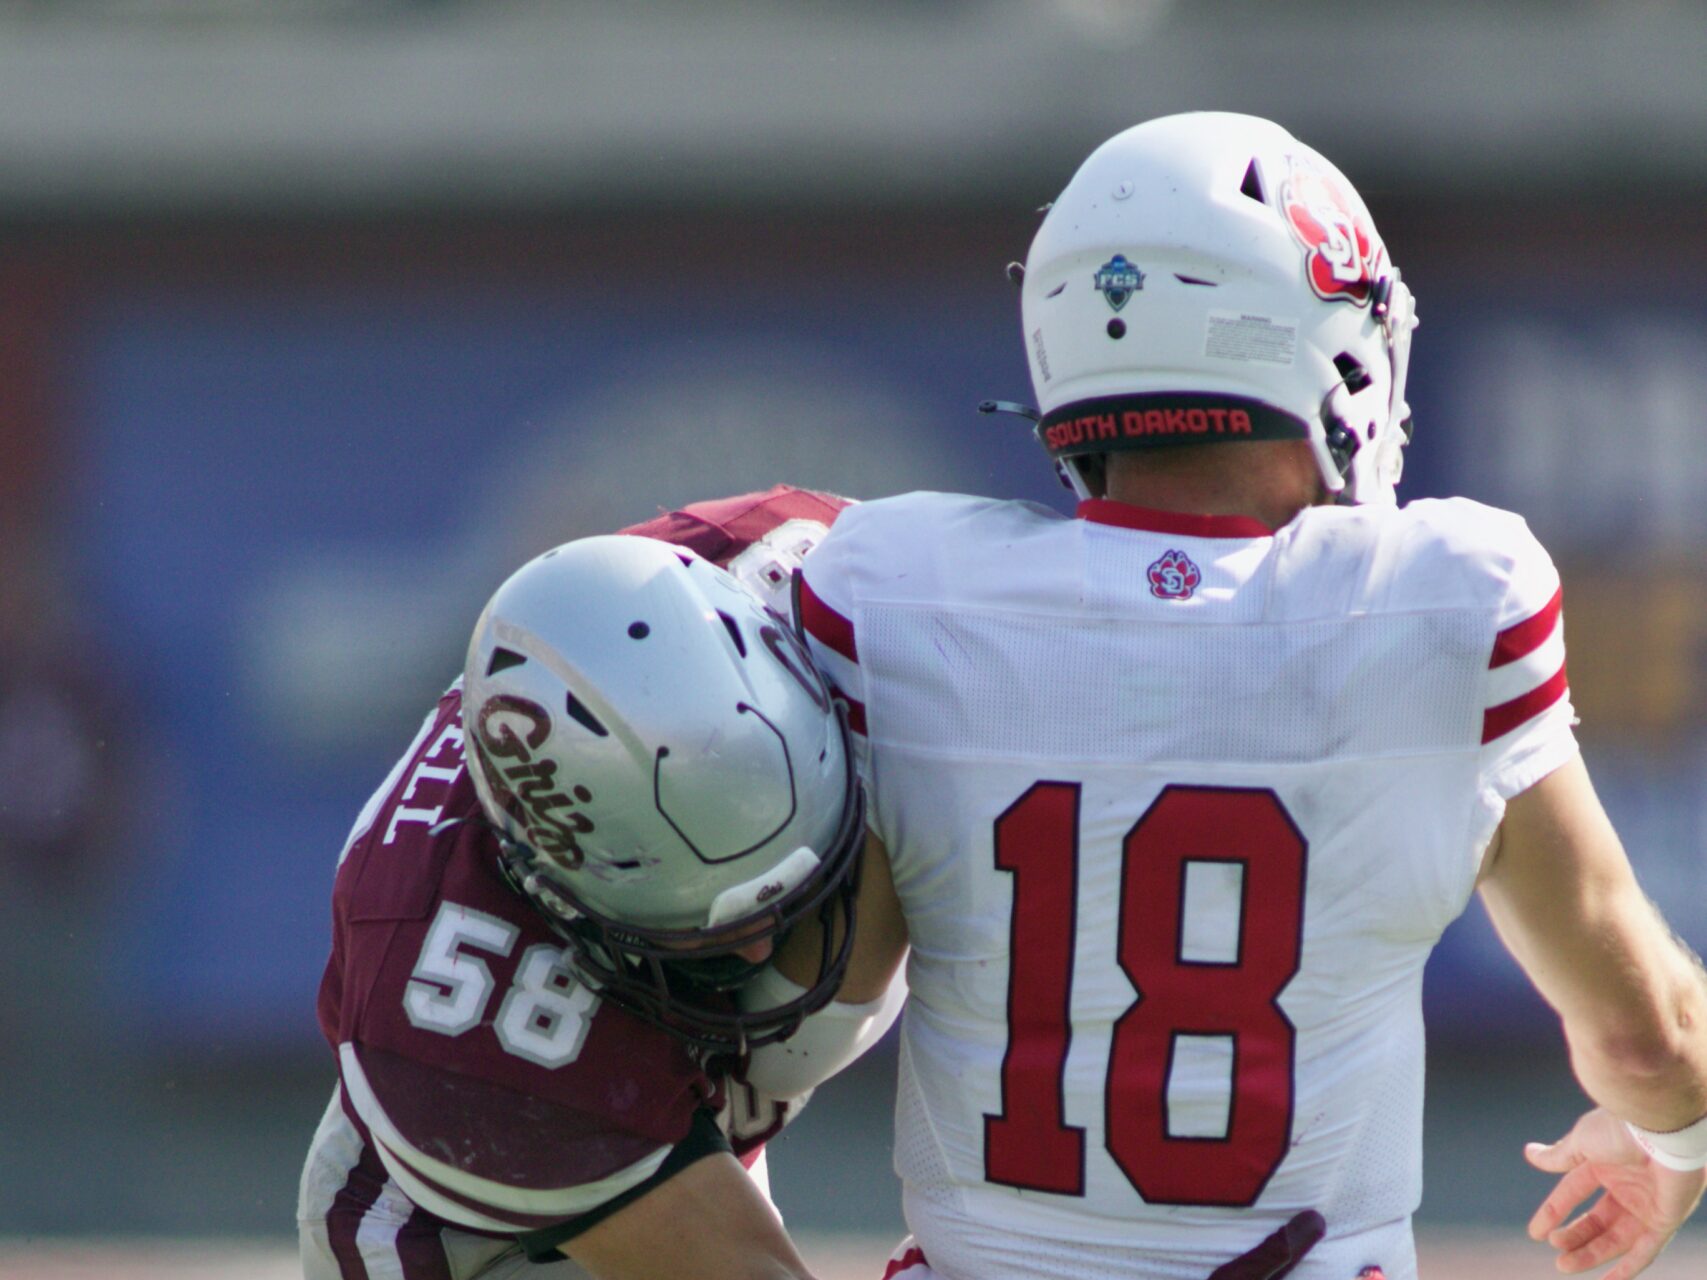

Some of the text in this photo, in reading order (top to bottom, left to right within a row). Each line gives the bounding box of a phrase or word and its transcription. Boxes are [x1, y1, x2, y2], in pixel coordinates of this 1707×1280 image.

[1044, 408, 1252, 449] SOUTH DAKOTA
[382, 709, 466, 846] ELL
[478, 694, 595, 871] Griz
[402, 899, 603, 1070] 58
[983, 780, 1309, 1207] 18
